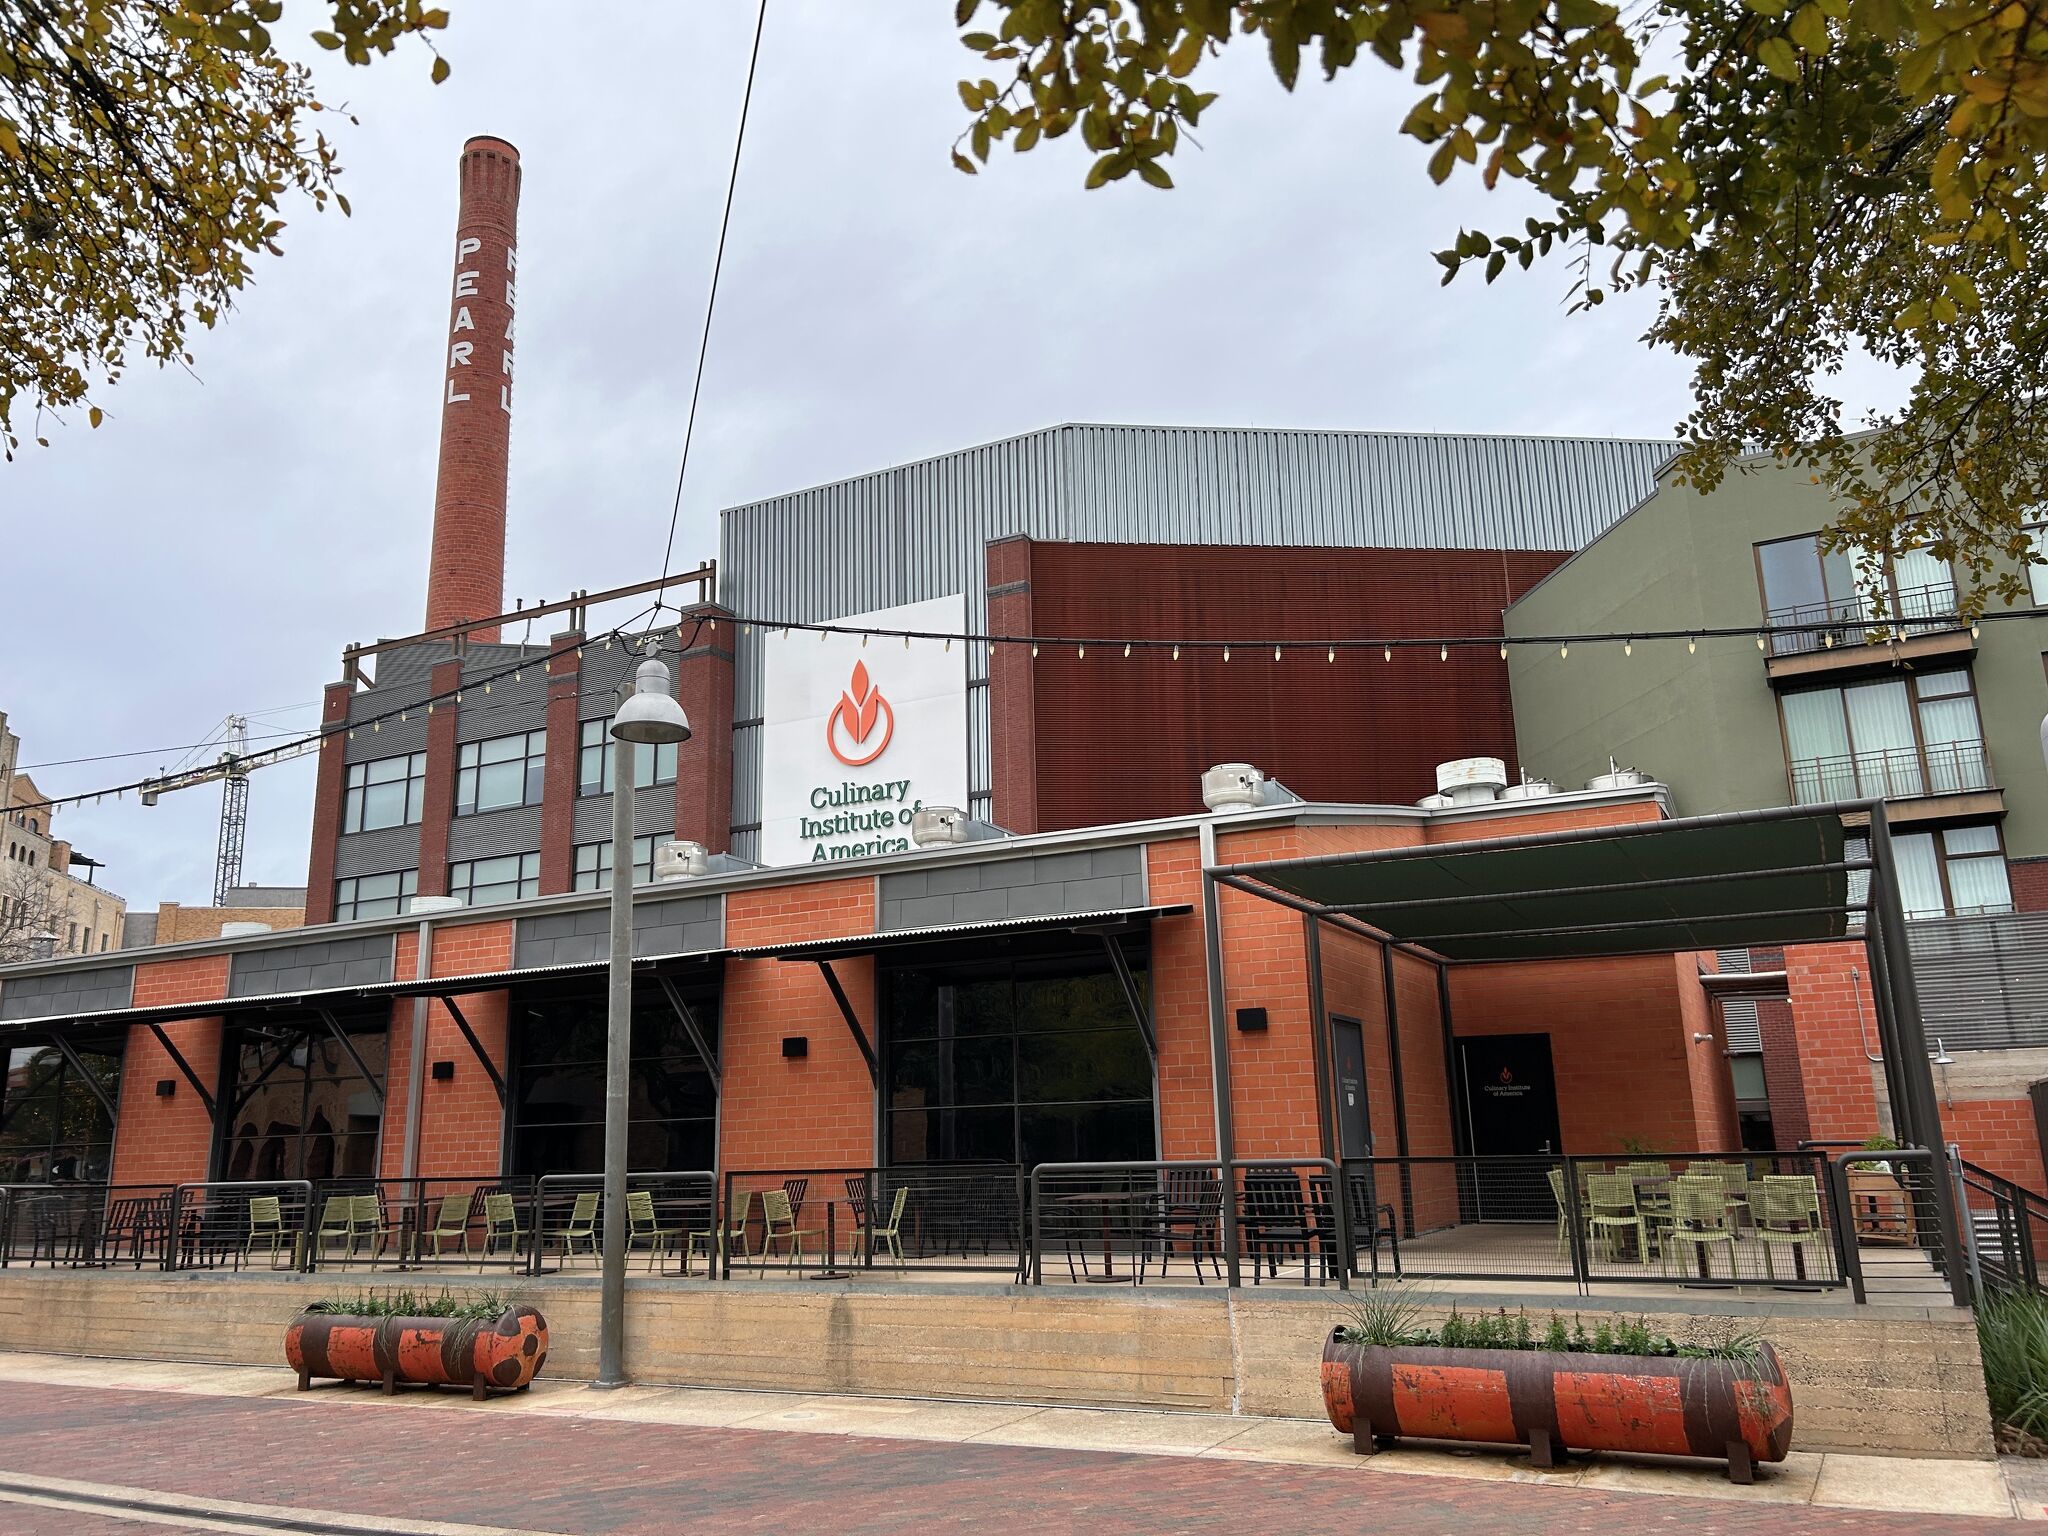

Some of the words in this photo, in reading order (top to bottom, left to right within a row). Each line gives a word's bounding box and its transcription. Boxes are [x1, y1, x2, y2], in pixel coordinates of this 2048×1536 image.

[448, 237, 482, 404] PEARL
[810, 780, 911, 809] Culinary
[799, 809, 895, 839] Institute
[898, 800, 922, 825] of
[811, 834, 909, 863] America
